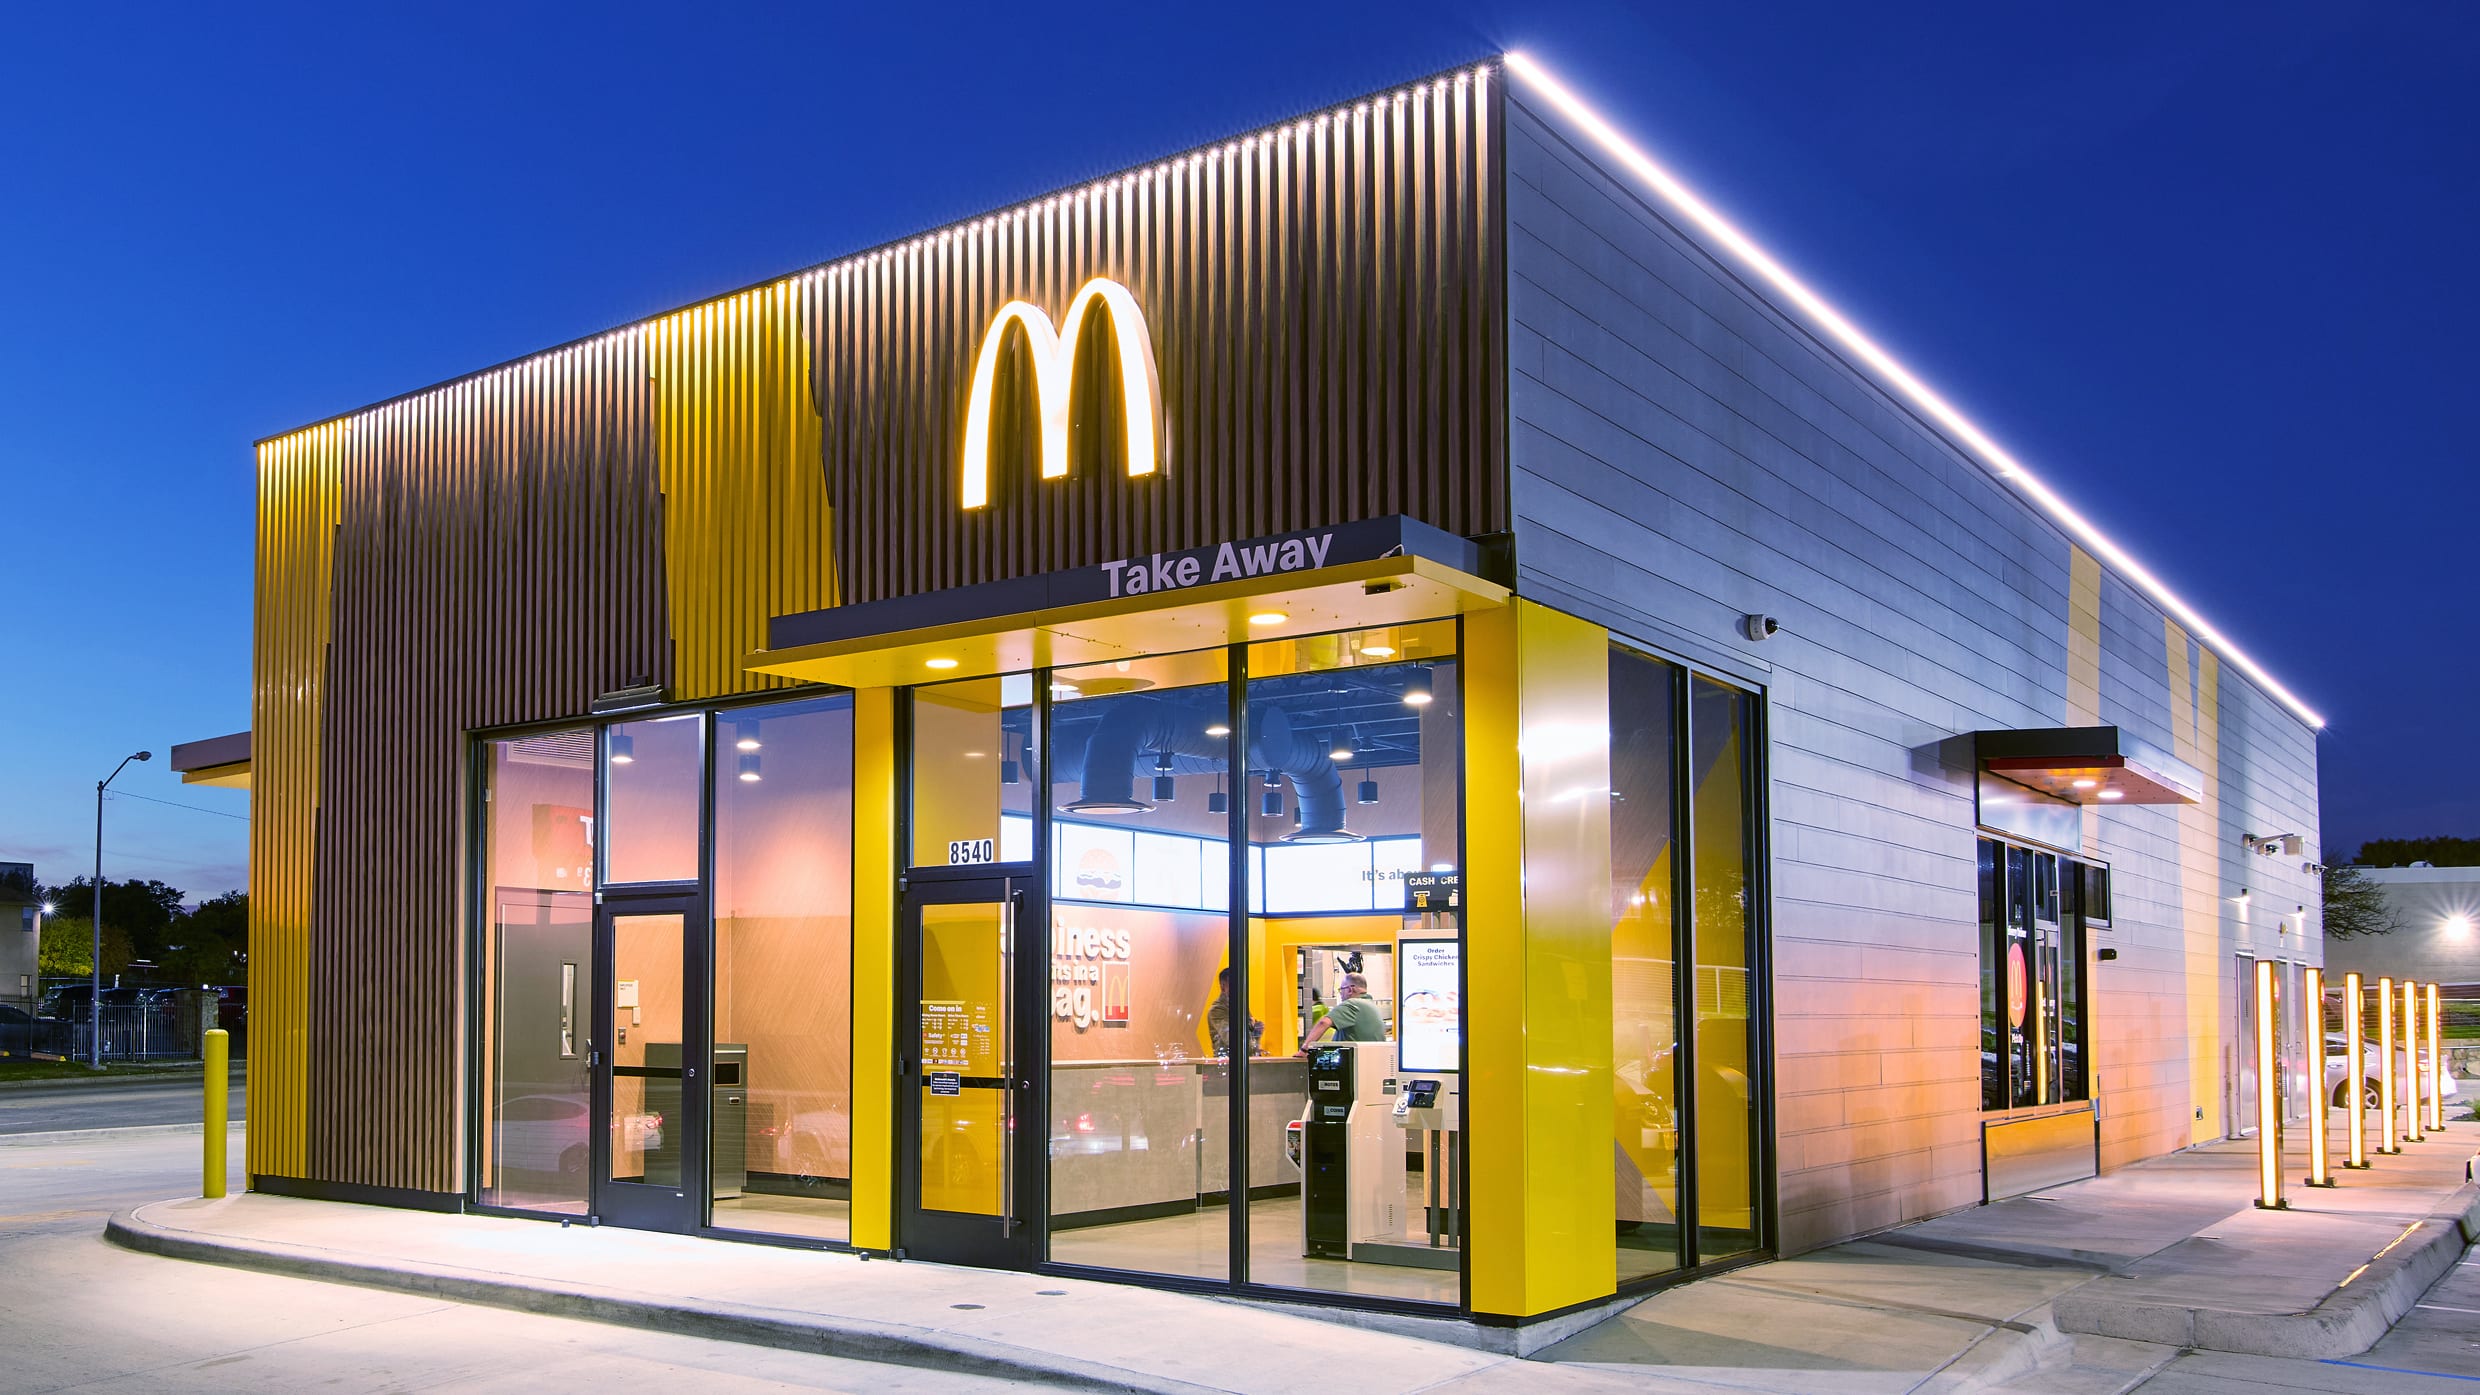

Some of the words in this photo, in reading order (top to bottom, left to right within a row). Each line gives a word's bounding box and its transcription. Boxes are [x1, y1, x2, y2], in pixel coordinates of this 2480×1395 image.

[1101, 553, 1200, 598] Take
[1210, 533, 1333, 582] Away
[950, 840, 992, 864] 8540
[1362, 869, 1385, 881] It's
[1409, 877, 1435, 886] CASH
[1052, 914, 1130, 959] iness
[1073, 959, 1088, 981] in
[1089, 965, 1099, 981] a
[1052, 987, 1099, 1028] ag.
